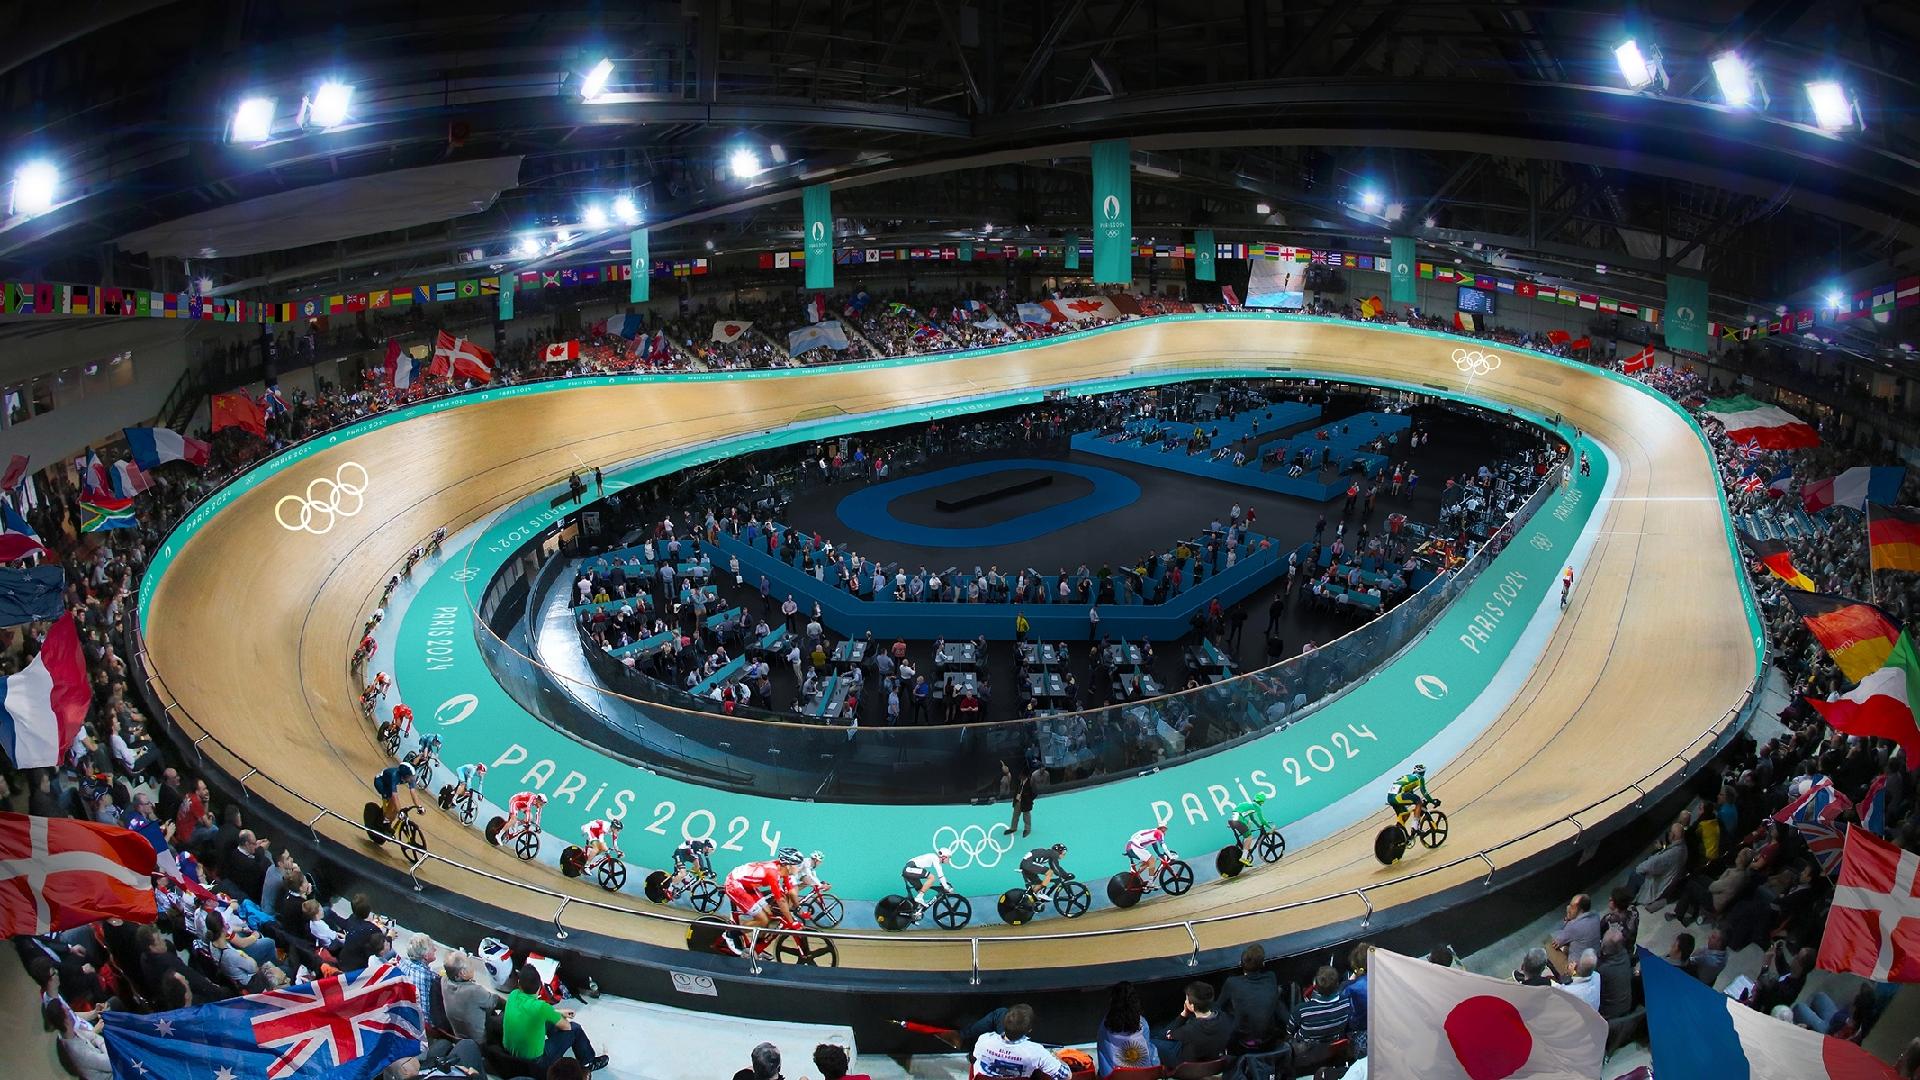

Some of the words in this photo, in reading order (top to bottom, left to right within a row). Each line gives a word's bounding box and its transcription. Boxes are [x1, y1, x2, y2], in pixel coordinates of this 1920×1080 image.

[1493, 571, 1528, 607] 2024
[426, 639, 454, 671] 2024
[1282, 722, 1377, 787] 2024
[646, 801, 782, 857] 2024
